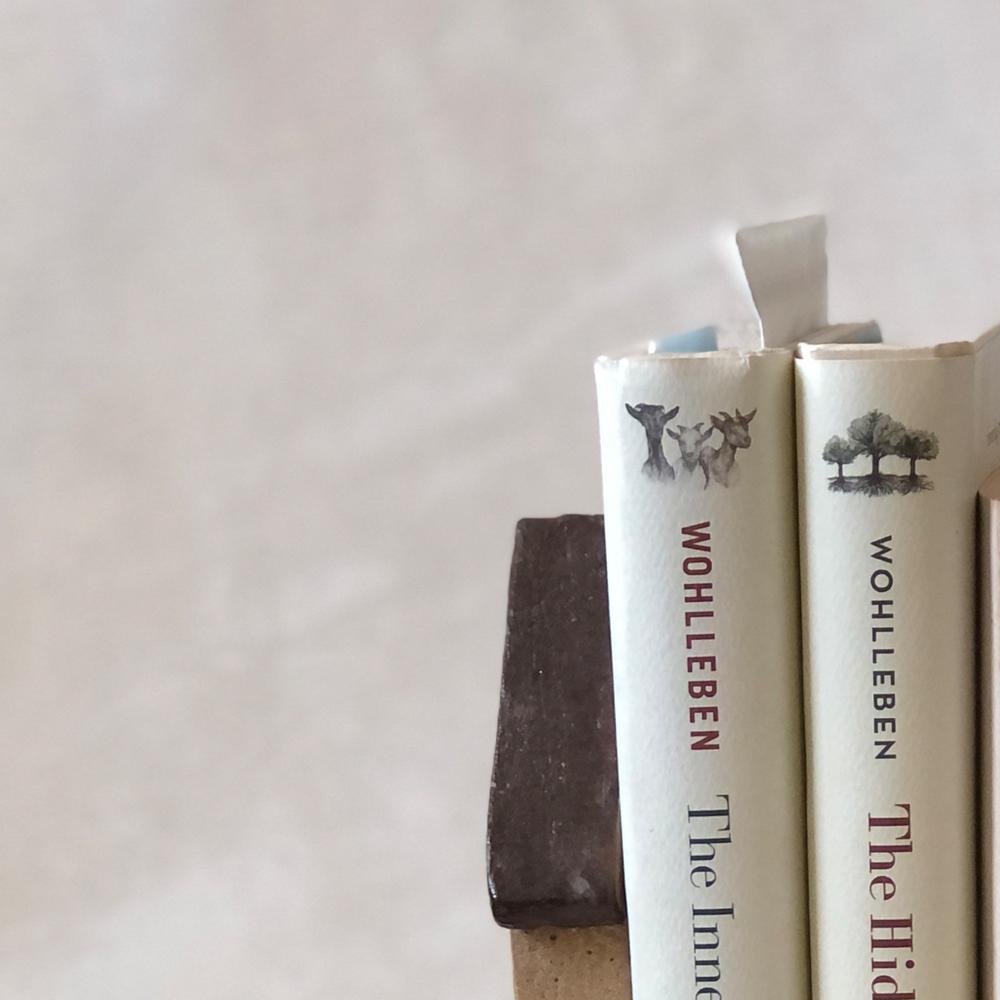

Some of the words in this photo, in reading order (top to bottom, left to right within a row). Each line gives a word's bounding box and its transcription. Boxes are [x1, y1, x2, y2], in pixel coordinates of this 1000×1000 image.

[681, 521, 720, 751] WOHLLEBEN
[870, 535, 897, 760] WOHLLEBEN
[687, 794, 732, 888] The
[868, 803, 913, 901] The
